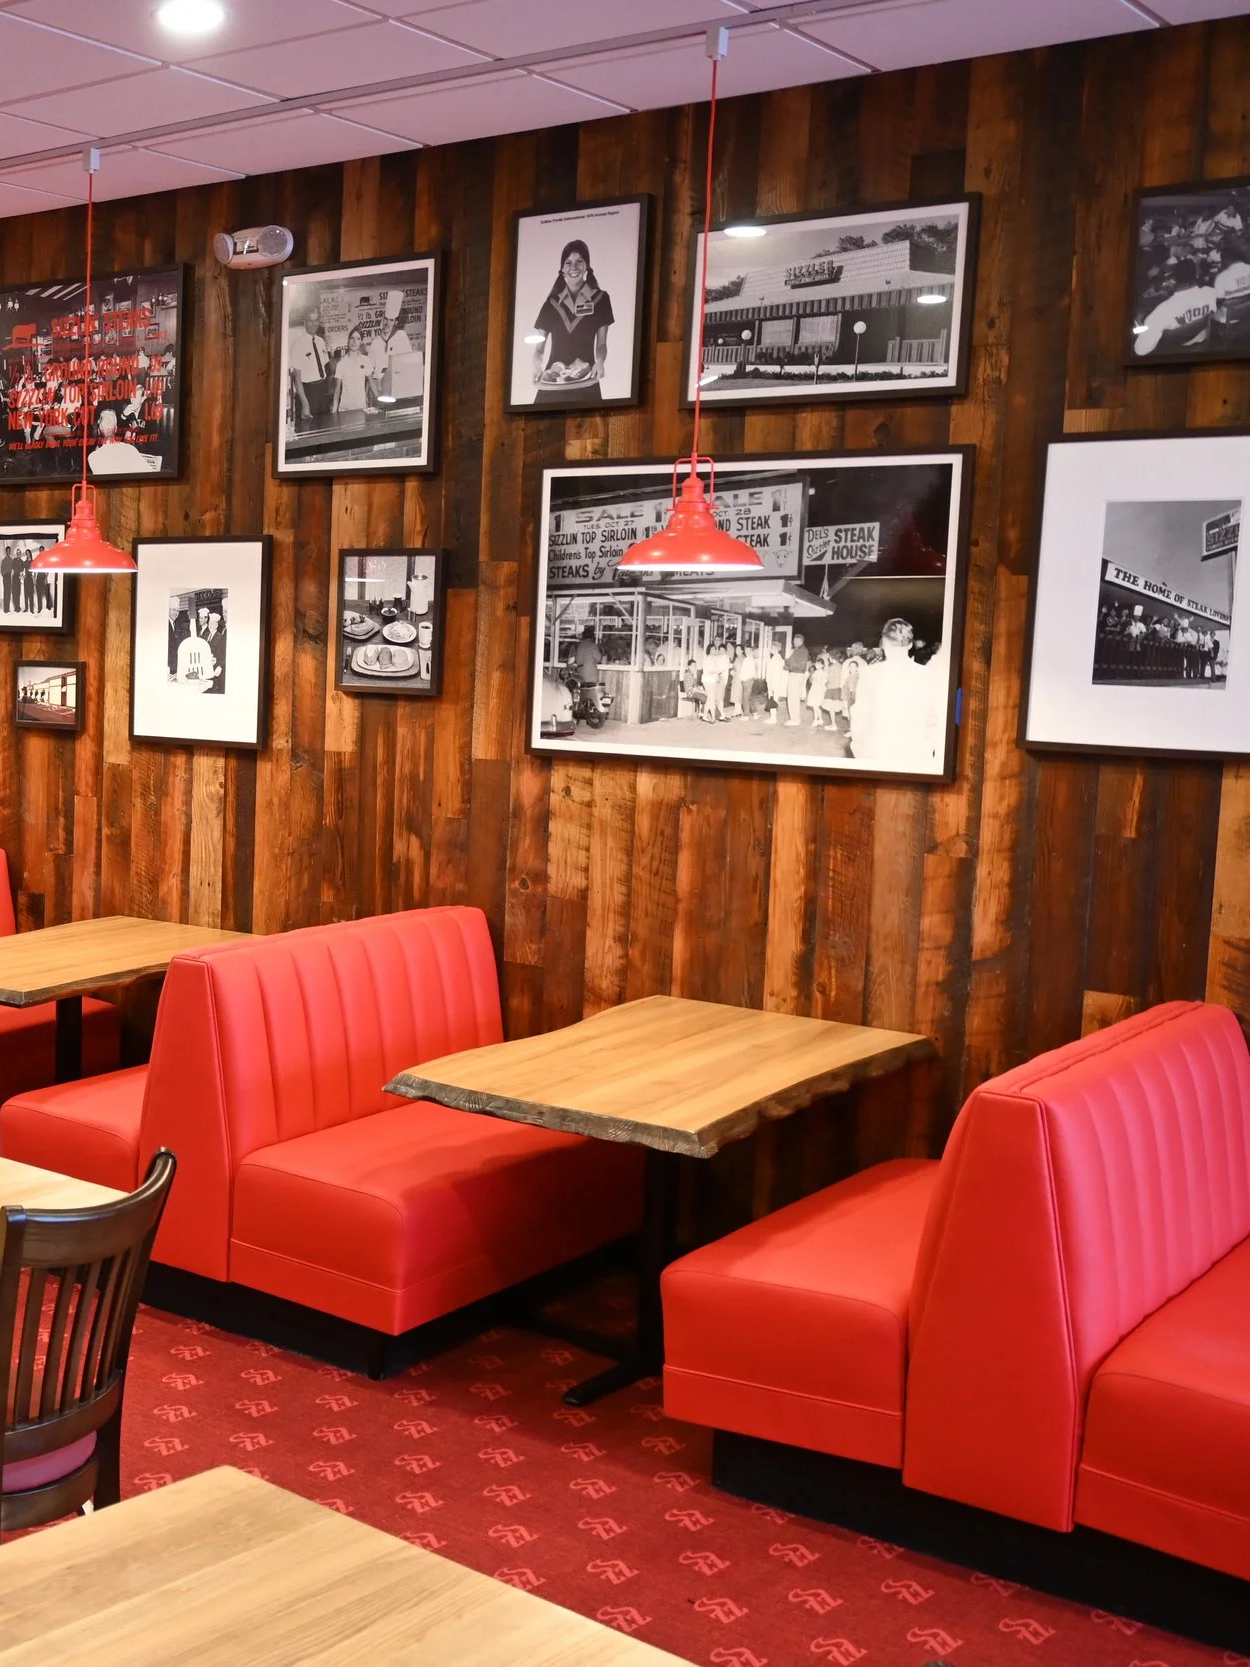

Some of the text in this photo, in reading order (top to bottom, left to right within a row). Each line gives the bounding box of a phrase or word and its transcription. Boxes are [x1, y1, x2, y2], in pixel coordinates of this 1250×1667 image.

[103, 307, 153, 334] STEAKS
[62, 381, 87, 405] TOP
[89, 378, 138, 402] SIRLOIN
[8, 408, 35, 431] NEW
[38, 407, 70, 428] YORK
[73, 405, 97, 426] CUT
[575, 504, 644, 524] SALE
[712, 491, 763, 508] ALE
[735, 508, 752, 516] 28
[581, 530, 597, 544] TOP
[601, 527, 637, 543] SIRLOIN
[736, 514, 771, 531] STEAK
[834, 526, 876, 544] STEAK
[584, 546, 597, 563] Top
[598, 544, 624, 559] Sirloin
[831, 543, 874, 561] HOUSE
[550, 563, 590, 579] STEAKS
[592, 561, 607, 580] by
[1114, 567, 1140, 587] THE
[1143, 580, 1172, 600] HOME
[1174, 593, 1186, 605] OF
[1187, 598, 1209, 614] STEAK
